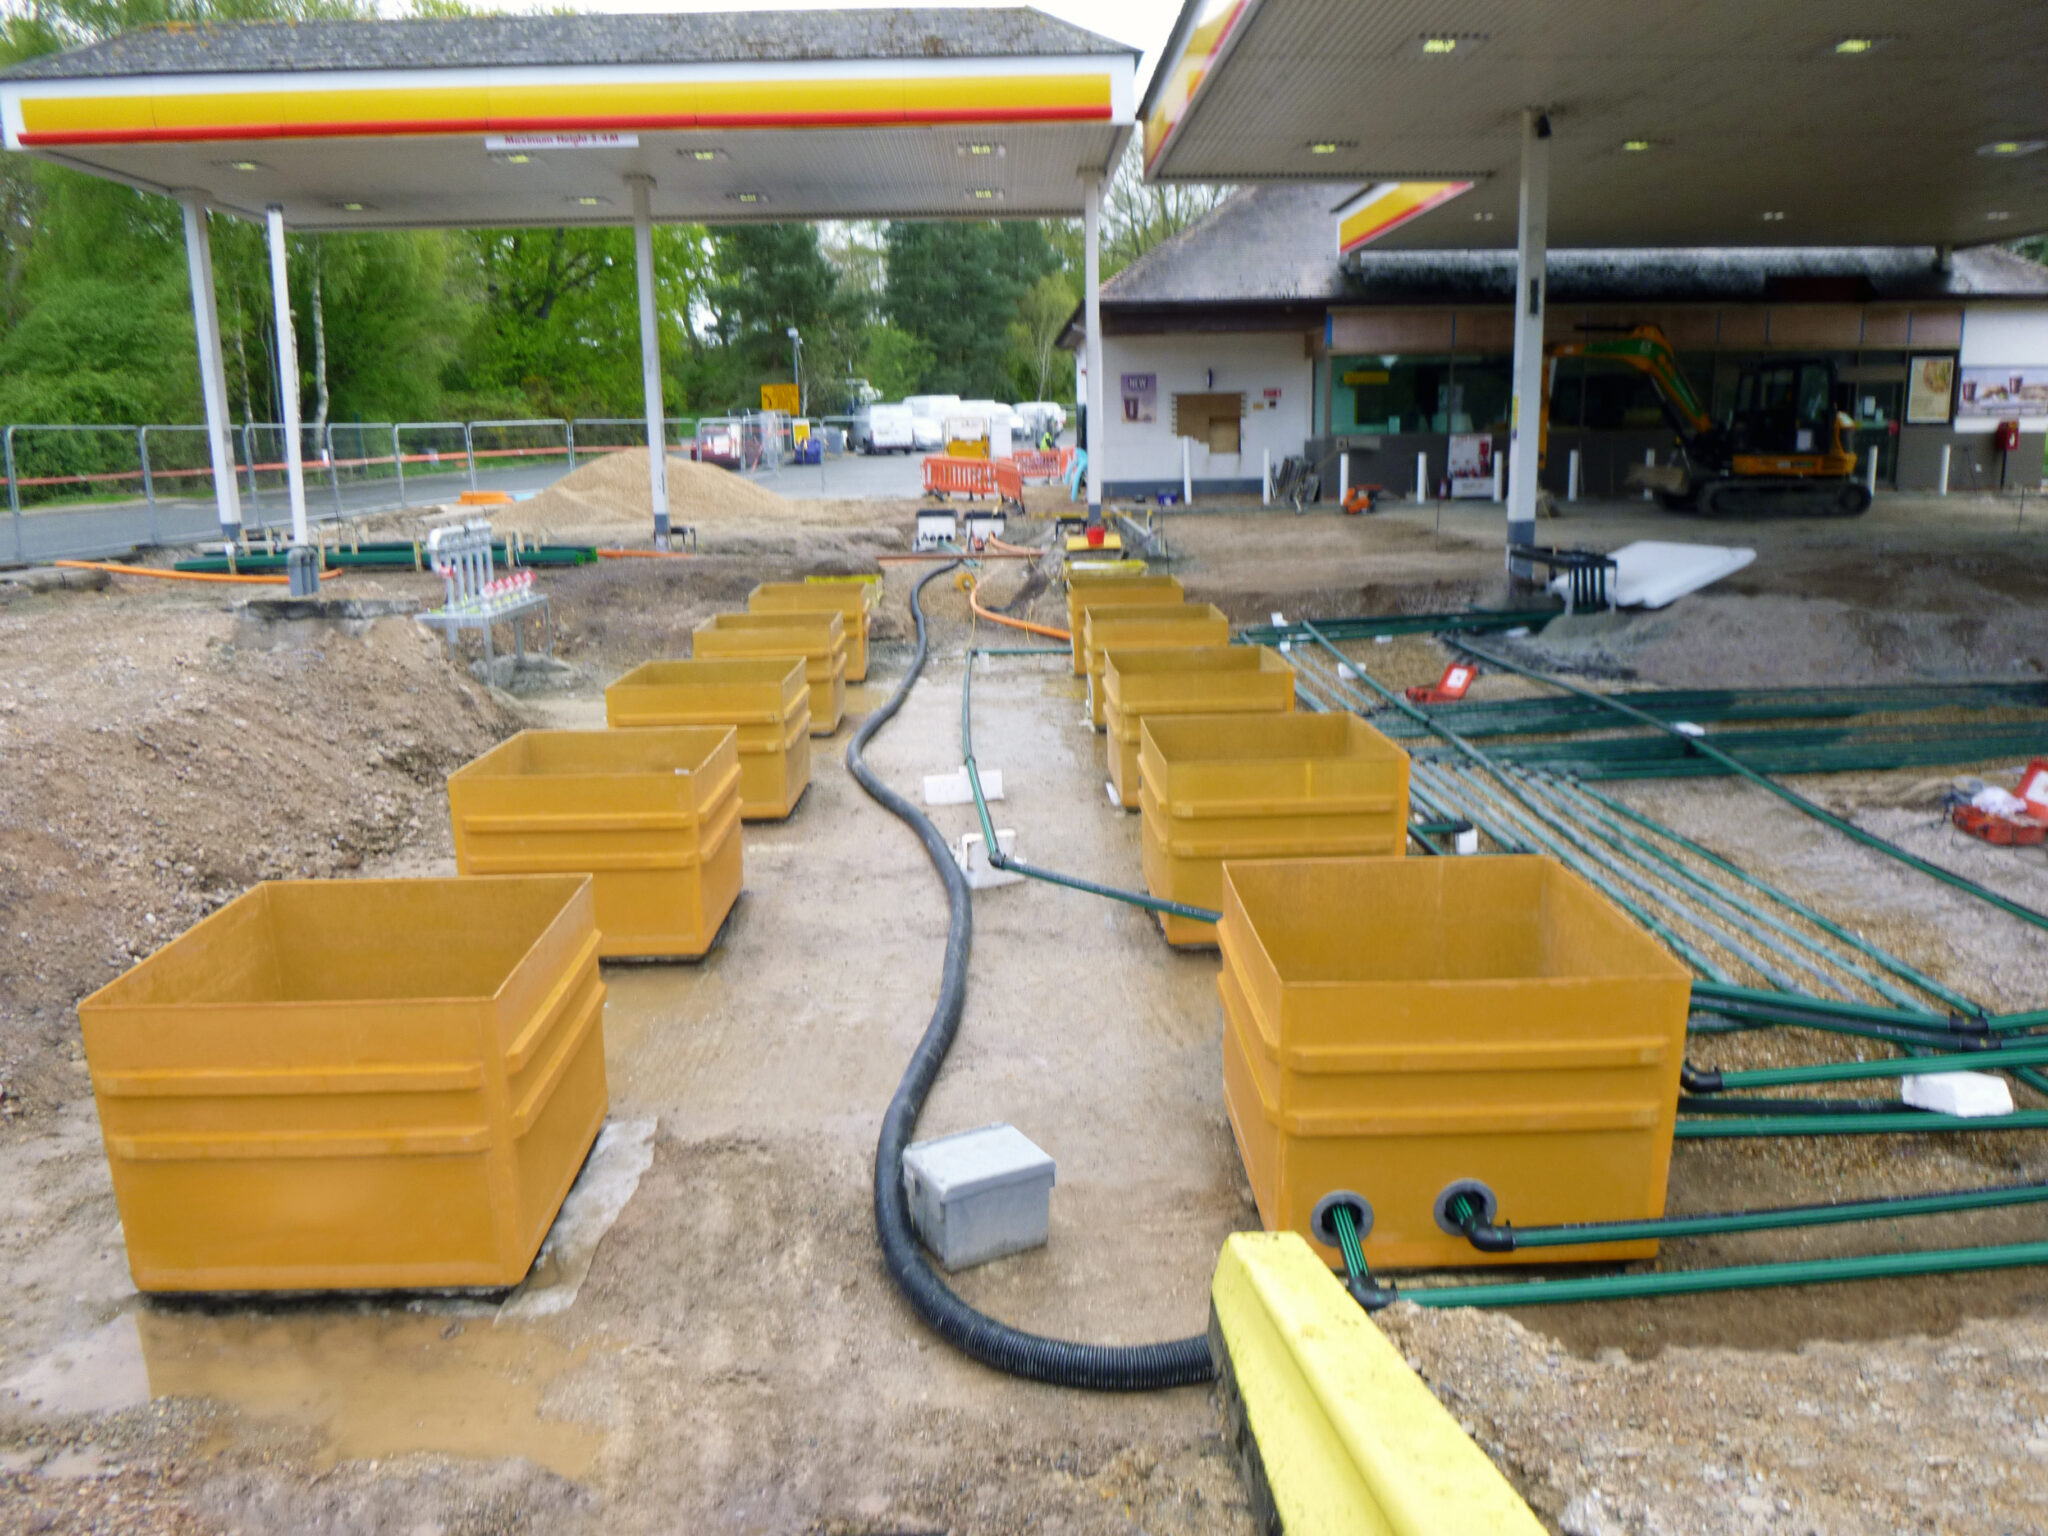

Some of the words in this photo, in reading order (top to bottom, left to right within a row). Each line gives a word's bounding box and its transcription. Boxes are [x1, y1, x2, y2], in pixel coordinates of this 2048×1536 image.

[504, 134, 553, 144] Maximum
[556, 133, 588, 148] Height
[1129, 376, 1146, 390] NEW
